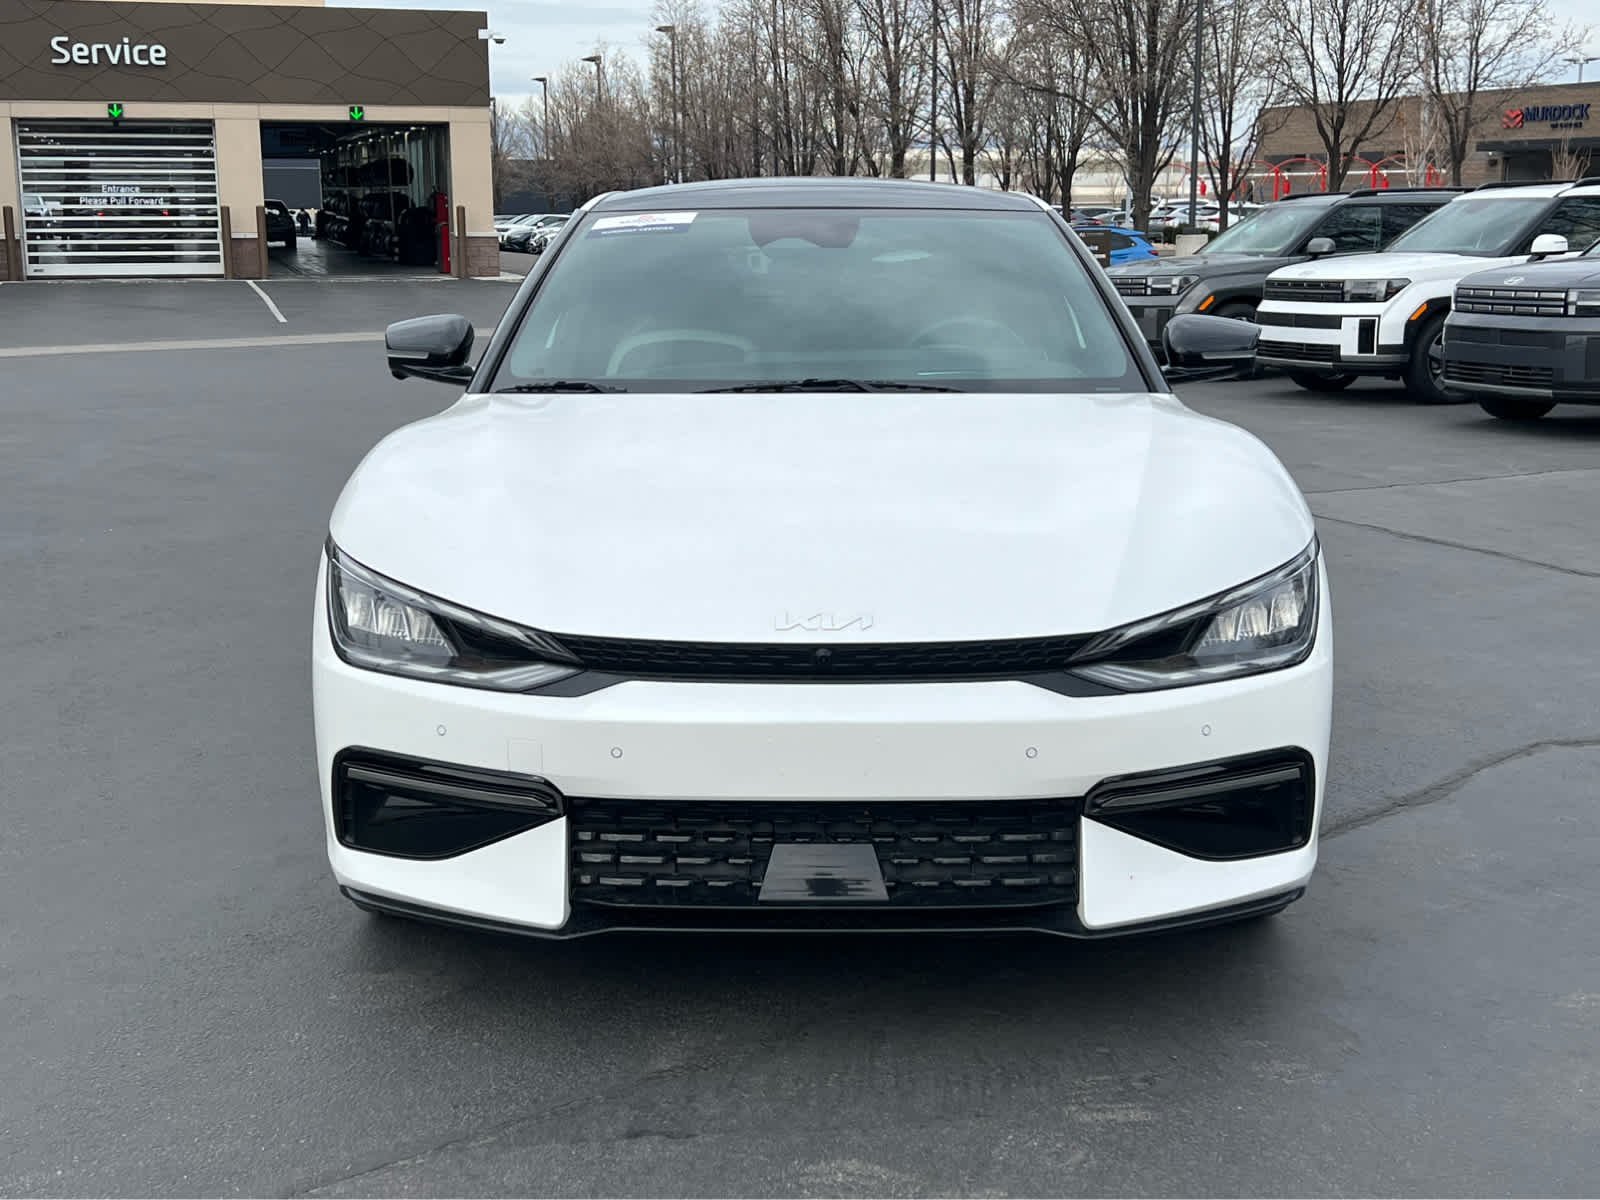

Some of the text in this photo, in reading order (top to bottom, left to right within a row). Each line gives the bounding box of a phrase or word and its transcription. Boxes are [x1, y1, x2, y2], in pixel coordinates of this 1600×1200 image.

[50, 36, 167, 66] Service
[1525, 103, 1591, 122] MURDOCK
[101, 184, 140, 193] Entrance
[79, 195, 164, 205] Please Pull Forward
